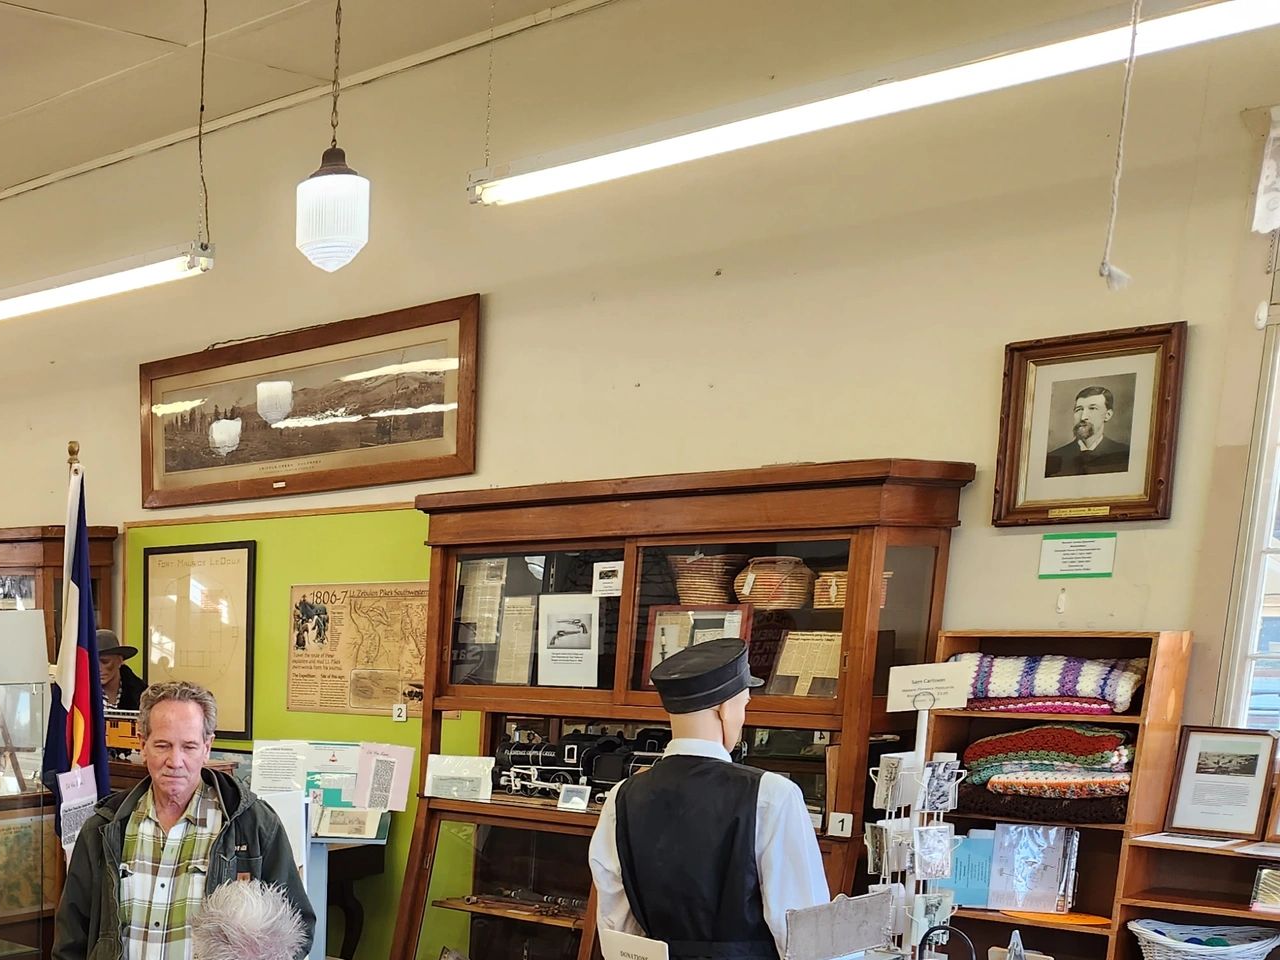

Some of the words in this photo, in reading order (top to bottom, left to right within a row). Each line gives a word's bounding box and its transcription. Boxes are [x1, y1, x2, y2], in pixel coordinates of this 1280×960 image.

[311, 589, 348, 605] 1806-7
[396, 708, 403, 718] 2
[818, 731, 825, 741] 4
[838, 818, 845, 832] 1
